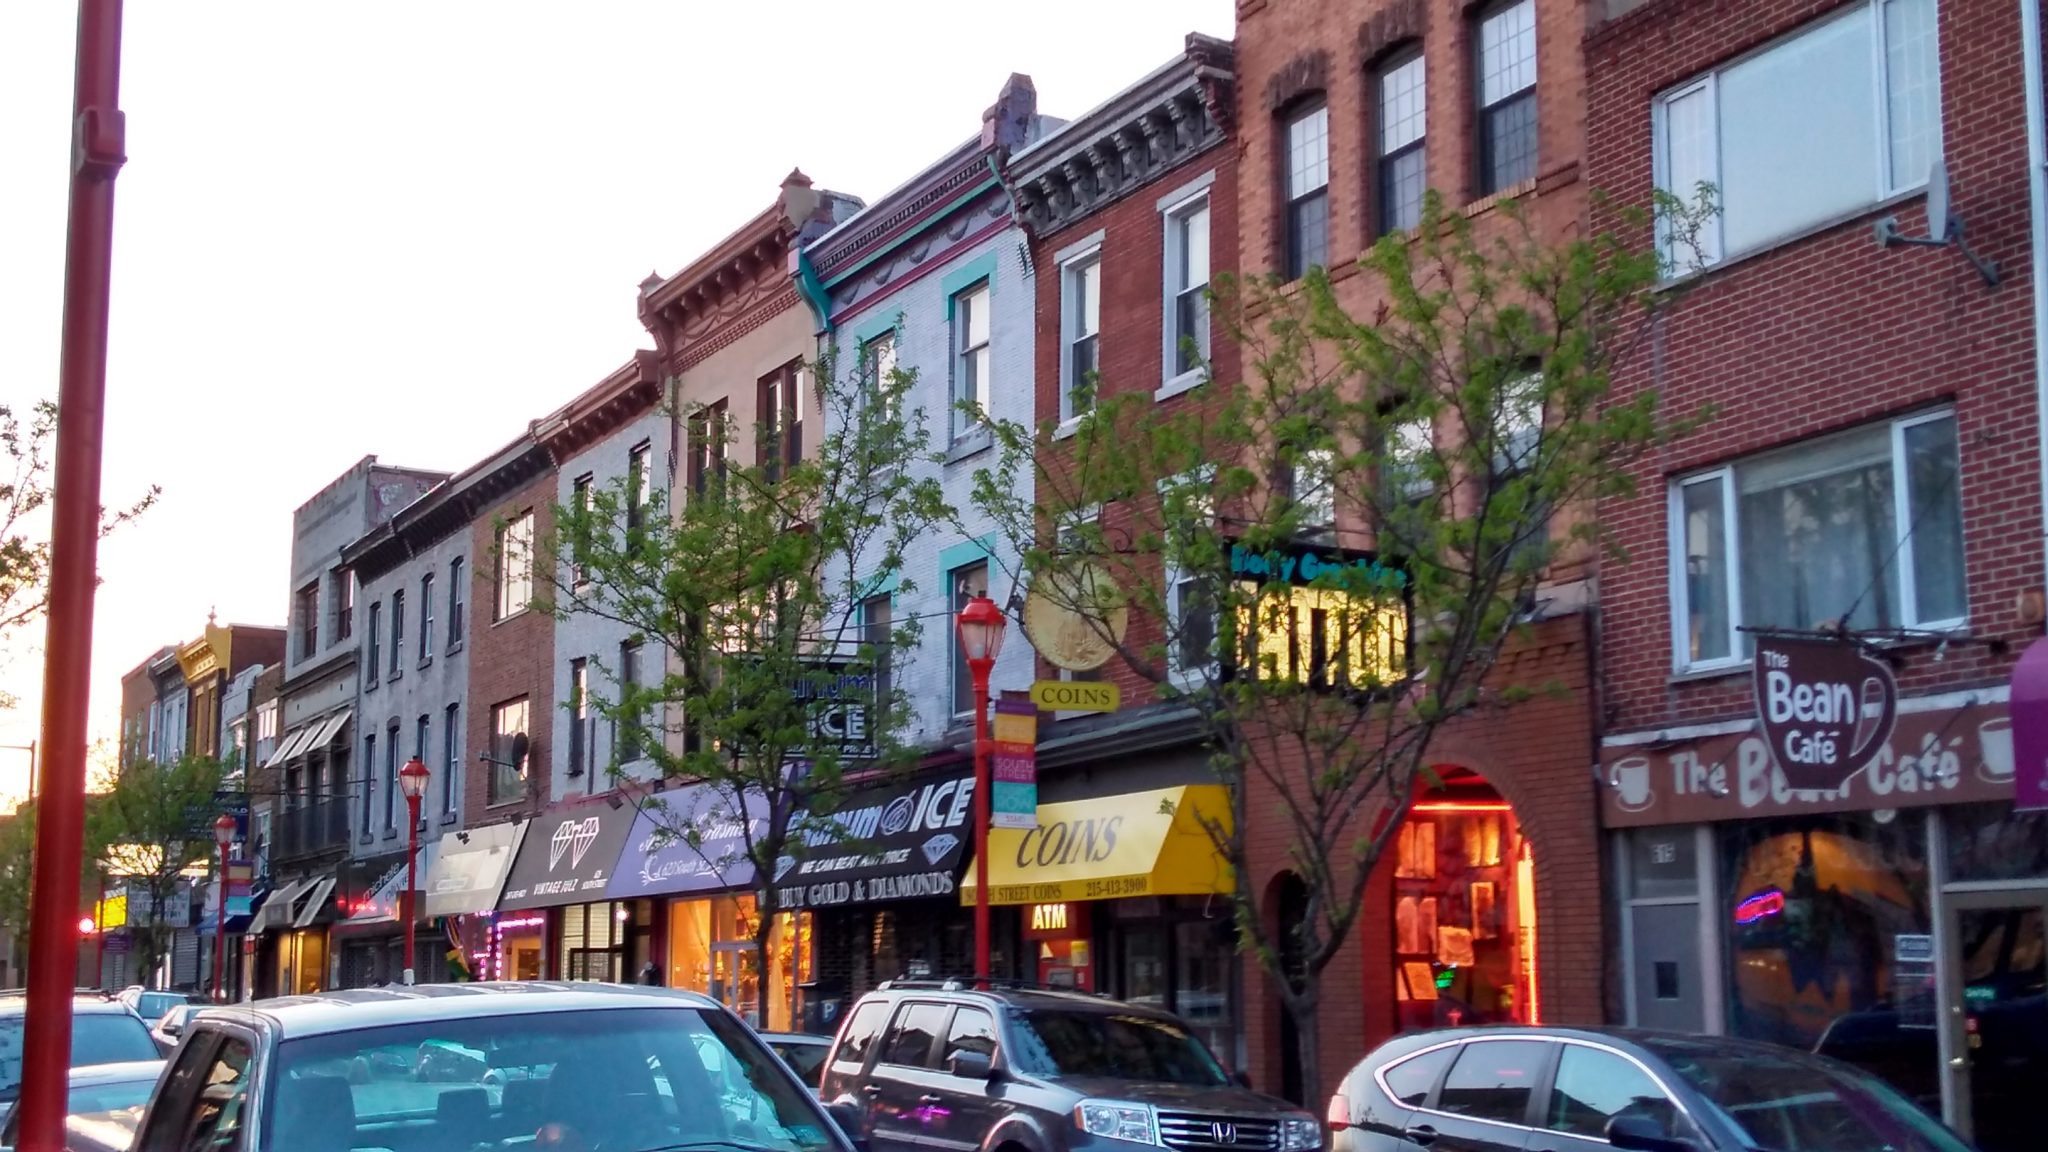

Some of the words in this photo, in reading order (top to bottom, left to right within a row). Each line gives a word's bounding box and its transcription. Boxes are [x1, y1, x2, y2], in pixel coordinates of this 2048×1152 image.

[1761, 650, 1790, 670] The
[1041, 687, 1111, 705] COINS
[1766, 671, 1855, 724] Bean
[1784, 730, 1841, 765] Café
[997, 757, 1034, 769] SOUTH
[997, 768, 1034, 780] STREET
[1669, 751, 1727, 796] The
[1738, 737, 1851, 808] Be
[1867, 732, 1964, 796] Café
[908, 776, 977, 832] ICE
[1017, 815, 1123, 868] COINS
[533, 880, 562, 896] VINTAGE
[778, 886, 808, 908] BUY
[808, 879, 850, 906] GOLD
[852, 879, 866, 902] &
[868, 870, 954, 900] DIAMONDS
[998, 885, 1031, 901] STREET
[1033, 884, 1062, 899] COINS
[1086, 876, 1148, 897] 215-413-3900
[1031, 903, 1068, 930] ATM
[823, 1002, 835, 1019] P
